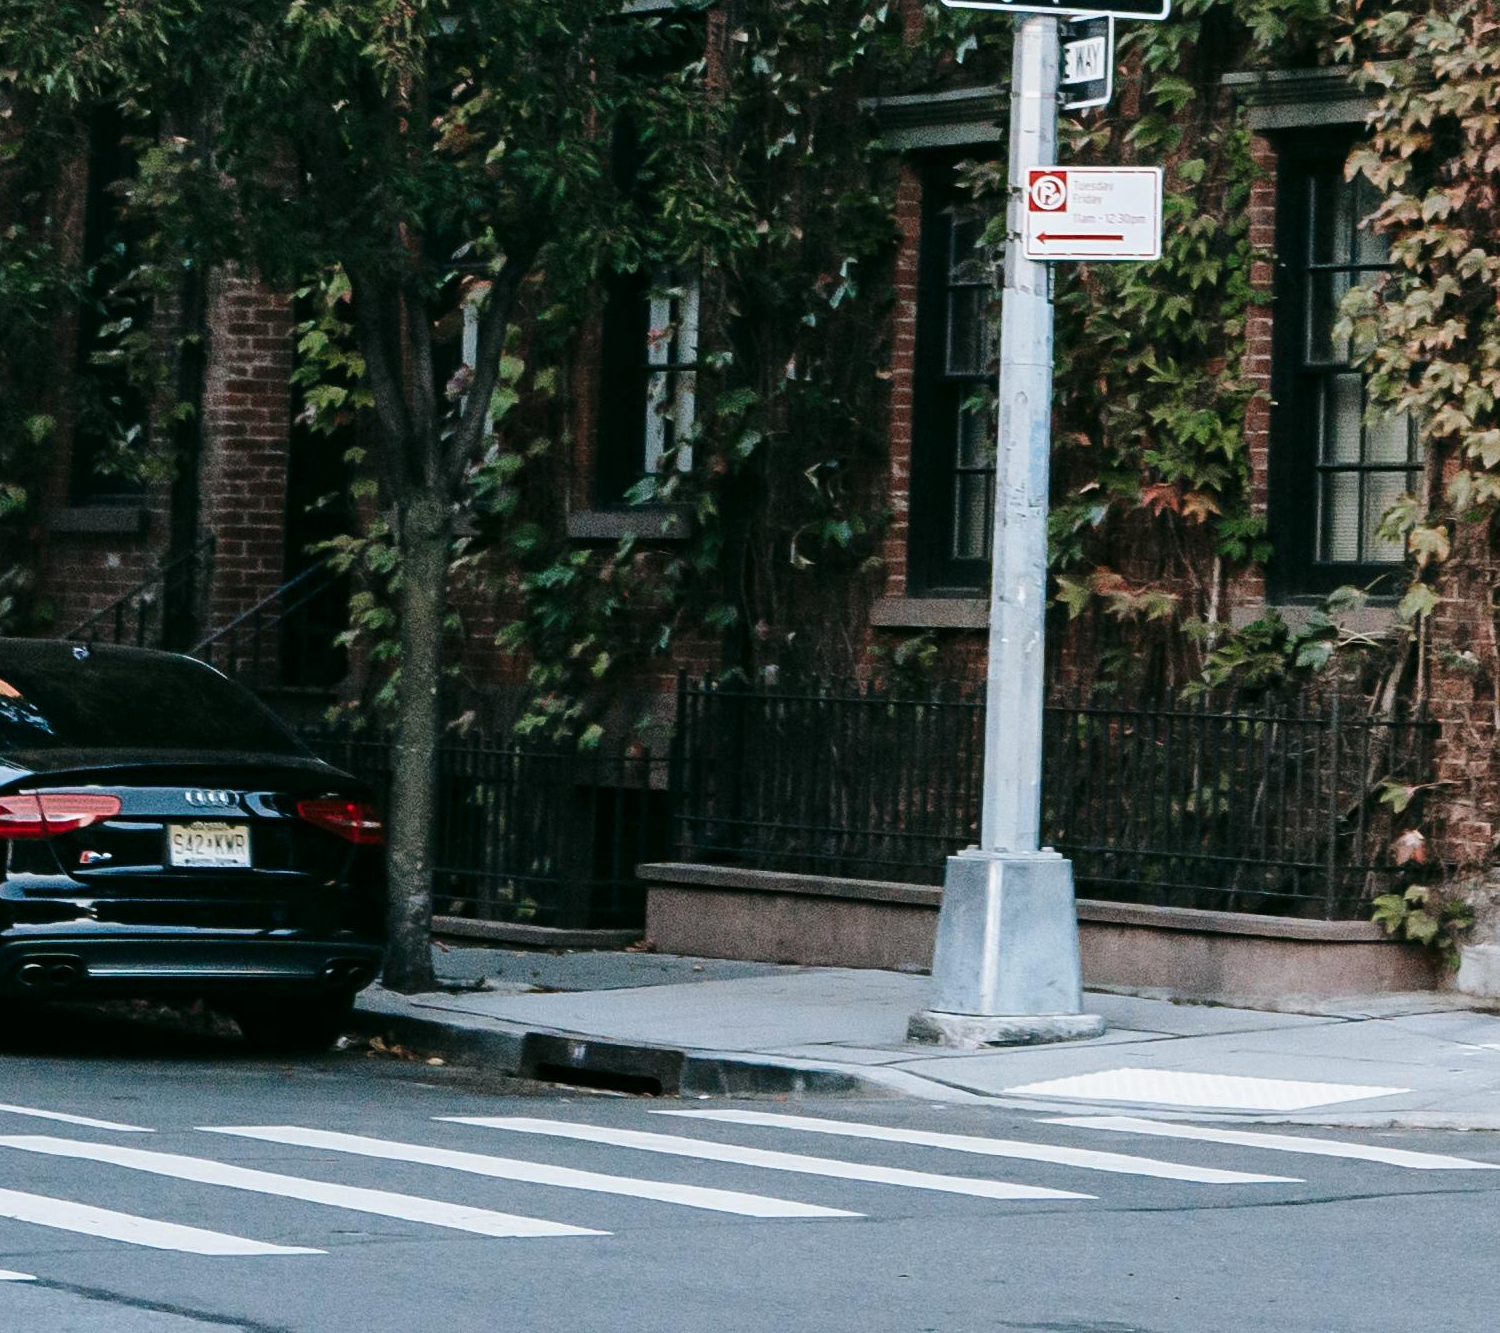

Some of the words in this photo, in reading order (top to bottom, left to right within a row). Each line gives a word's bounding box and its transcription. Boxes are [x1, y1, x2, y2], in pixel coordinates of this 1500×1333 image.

[1075, 42, 1102, 78] WAY
[1073, 180, 1114, 191] Tuesday
[1072, 193, 1103, 205] Friday
